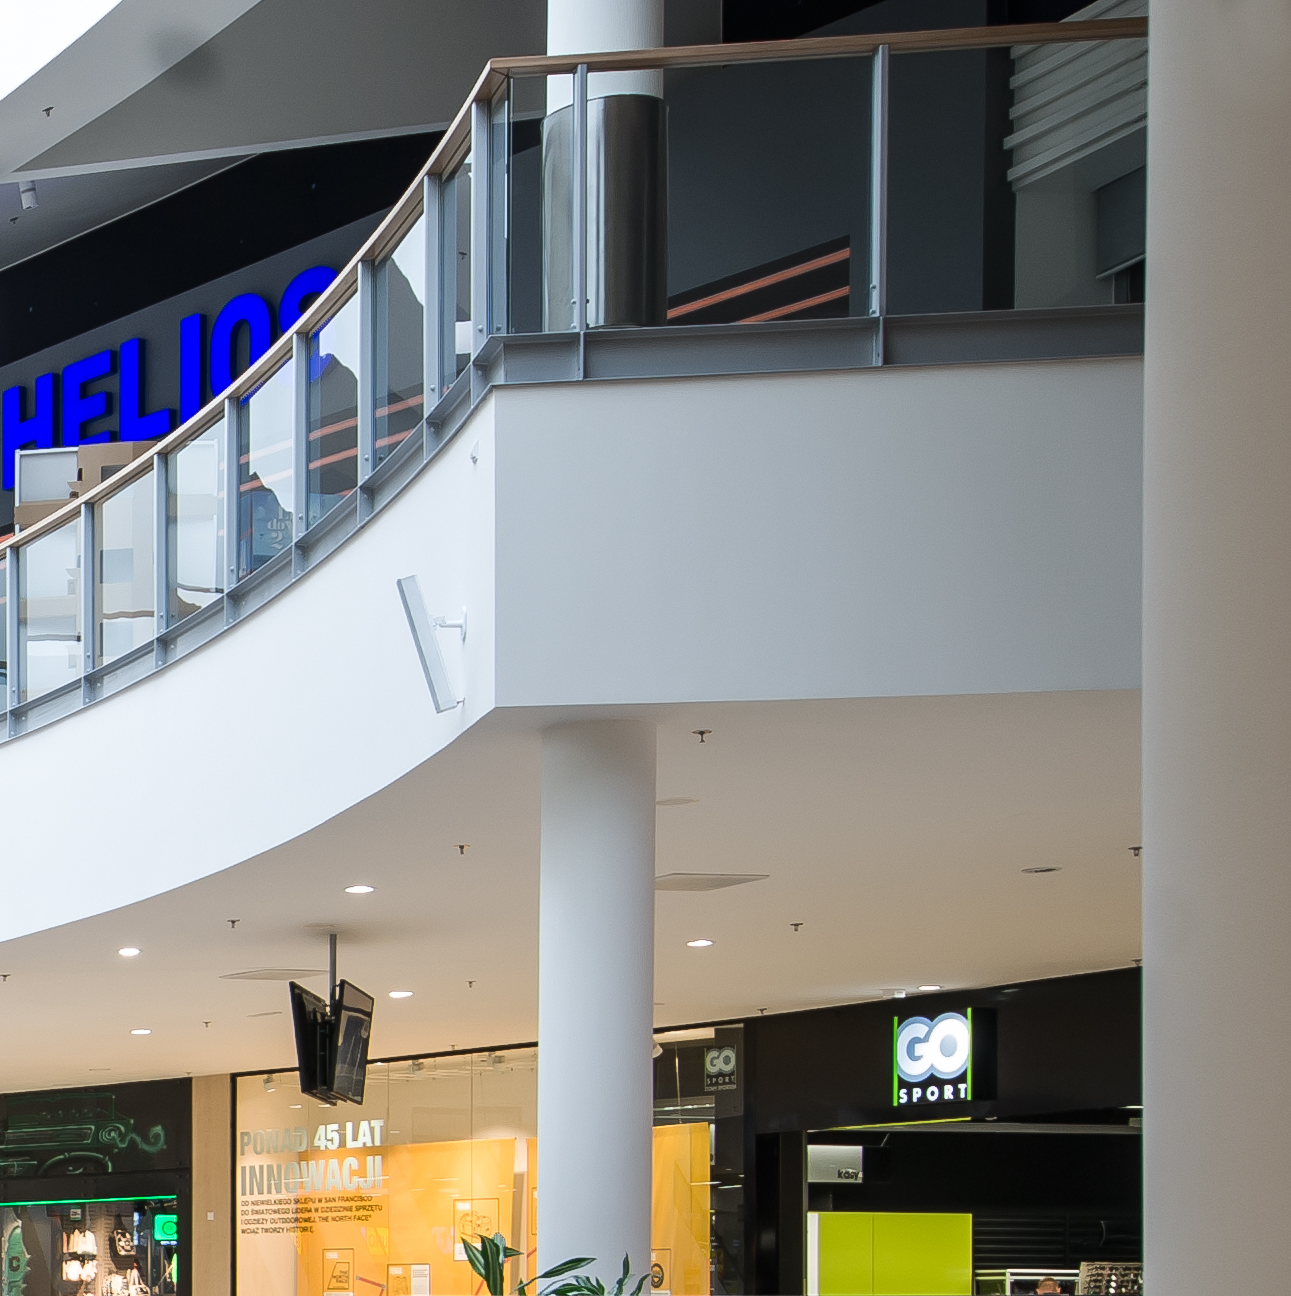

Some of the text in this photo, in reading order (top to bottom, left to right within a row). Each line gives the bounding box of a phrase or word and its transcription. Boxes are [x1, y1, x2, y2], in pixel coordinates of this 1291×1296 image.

[2, 266, 339, 490] HELIOS
[706, 1047, 736, 1075] GO
[897, 1012, 971, 1082] GO
[706, 1076, 735, 1085] SPORT
[899, 1083, 968, 1103] SPORT
[240, 1119, 384, 1156] PONAD 45 LAT
[241, 1155, 382, 1196] INNOWACJI
[837, 1169, 860, 1181] kasy
